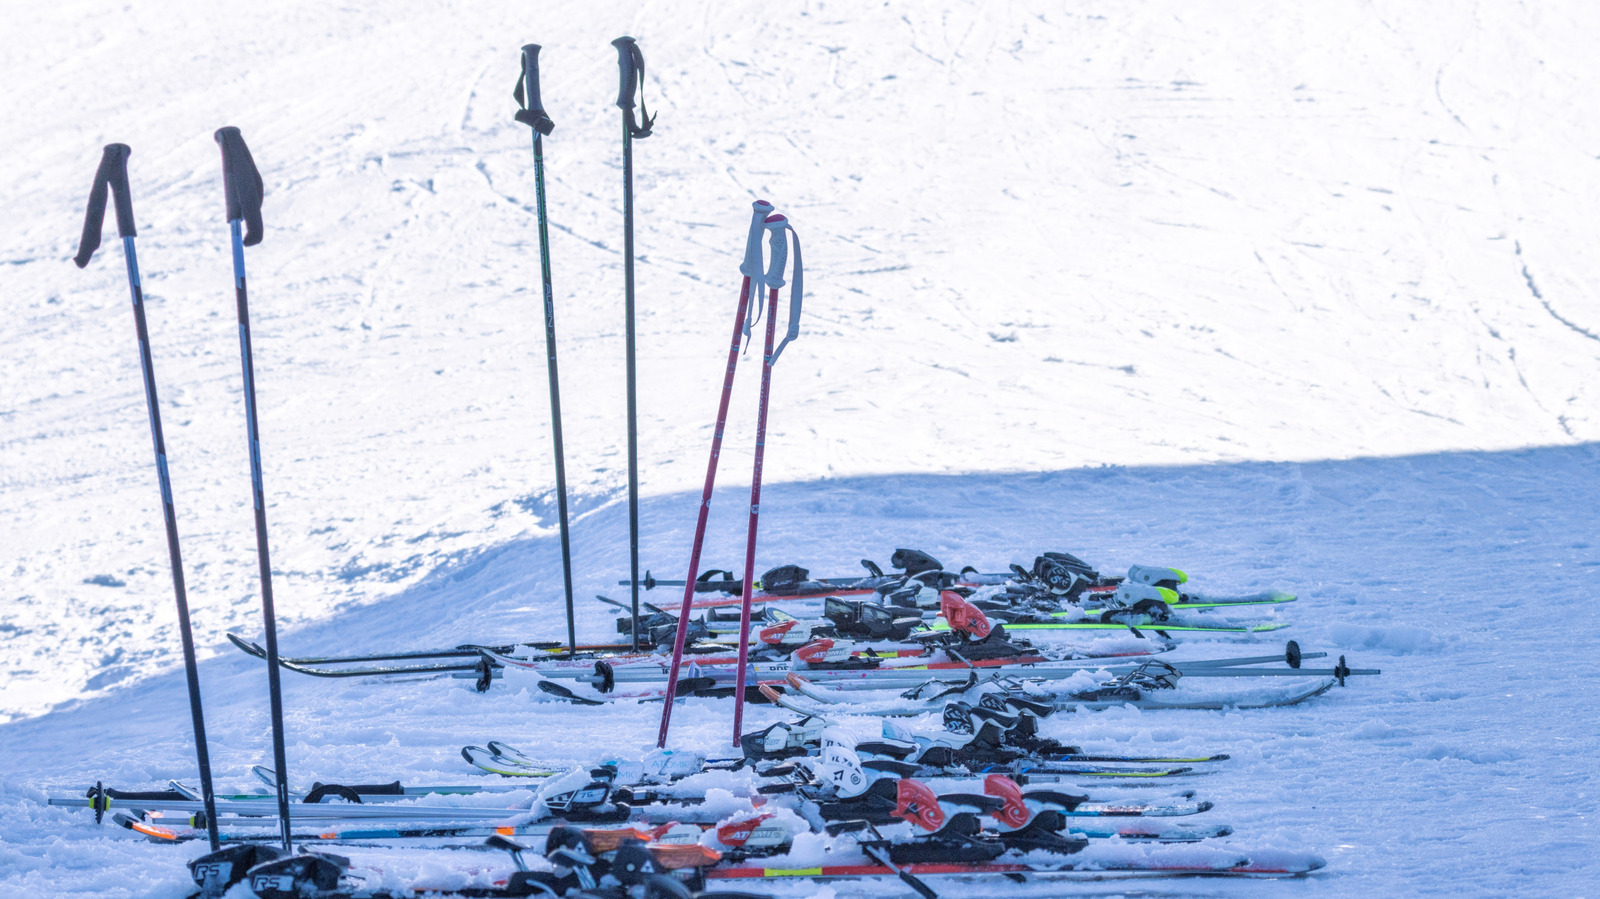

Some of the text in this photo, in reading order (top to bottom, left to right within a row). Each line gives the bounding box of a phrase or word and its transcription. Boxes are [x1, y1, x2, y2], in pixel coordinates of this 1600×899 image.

[545, 283, 553, 328] ALPIN
[651, 759, 689, 770] ATOMIC
[731, 830, 781, 840] ATOMIC
[195, 865, 220, 880] RS
[254, 876, 281, 891] RS
